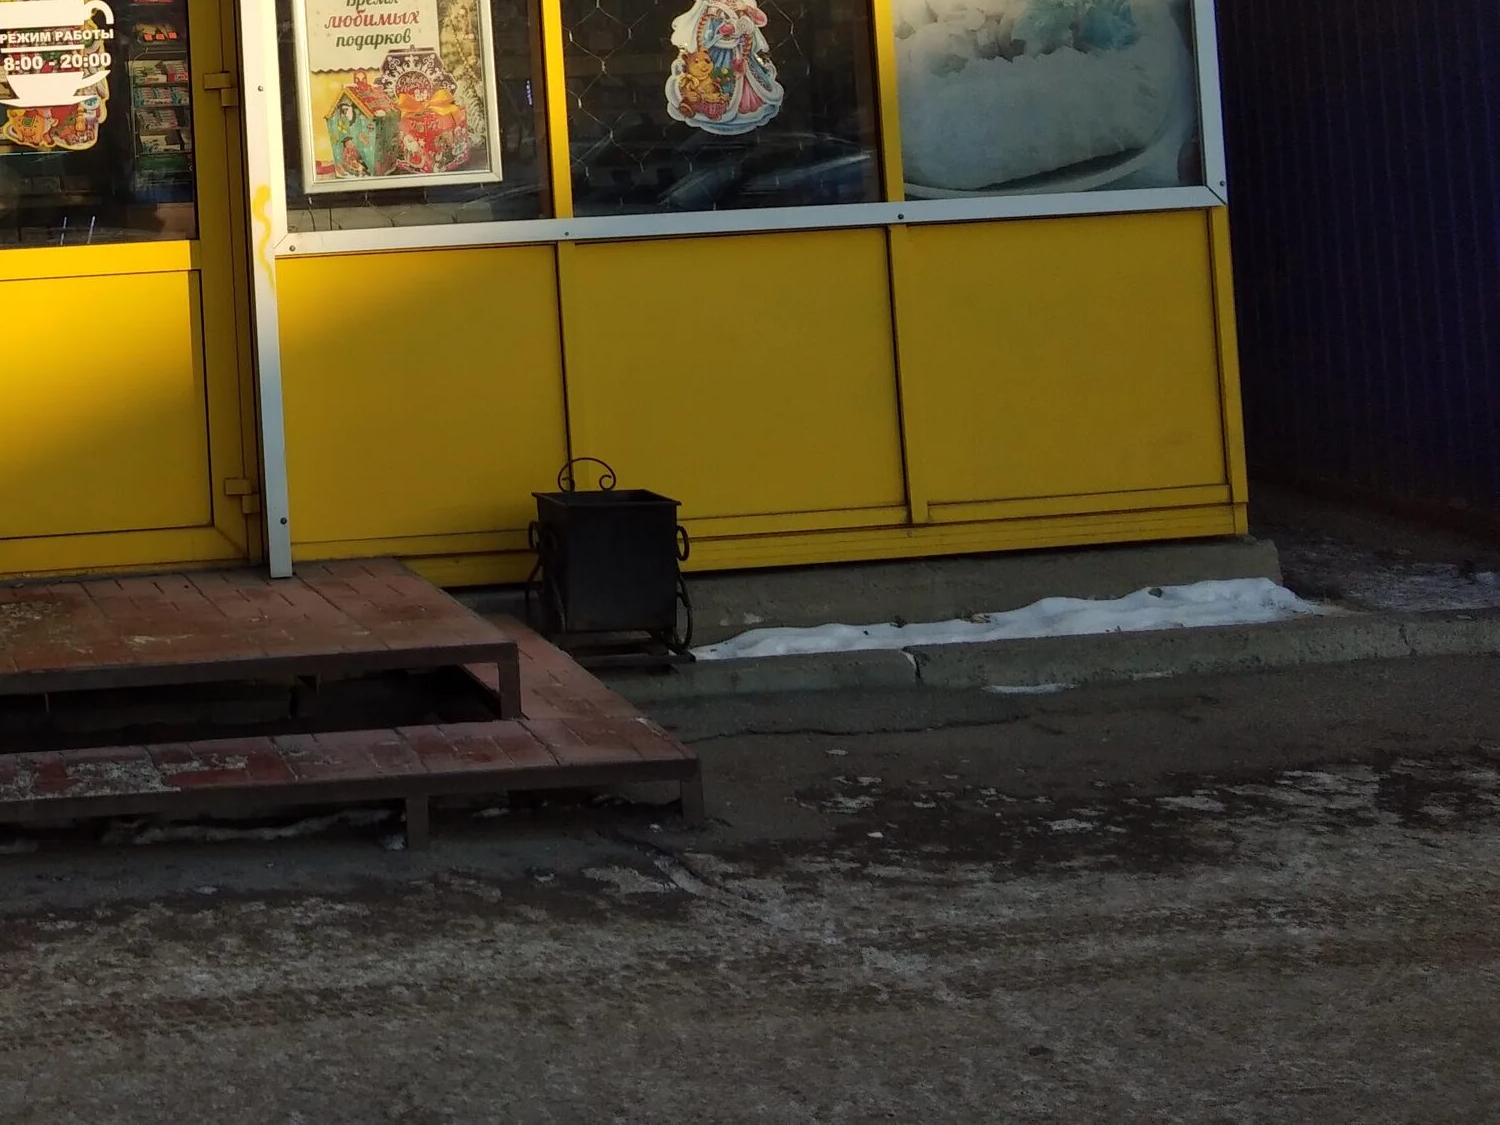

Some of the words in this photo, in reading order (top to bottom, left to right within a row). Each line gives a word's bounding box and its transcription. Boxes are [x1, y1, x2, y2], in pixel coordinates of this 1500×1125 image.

[324, 9, 420, 29] любимых
[0, 31, 52, 44] РЕЖИМ
[55, 28, 114, 41] РАБОТЫ
[336, 28, 412, 51] подарков
[3, 56, 43, 71] 8:00
[60, 52, 111, 68] 20:00
